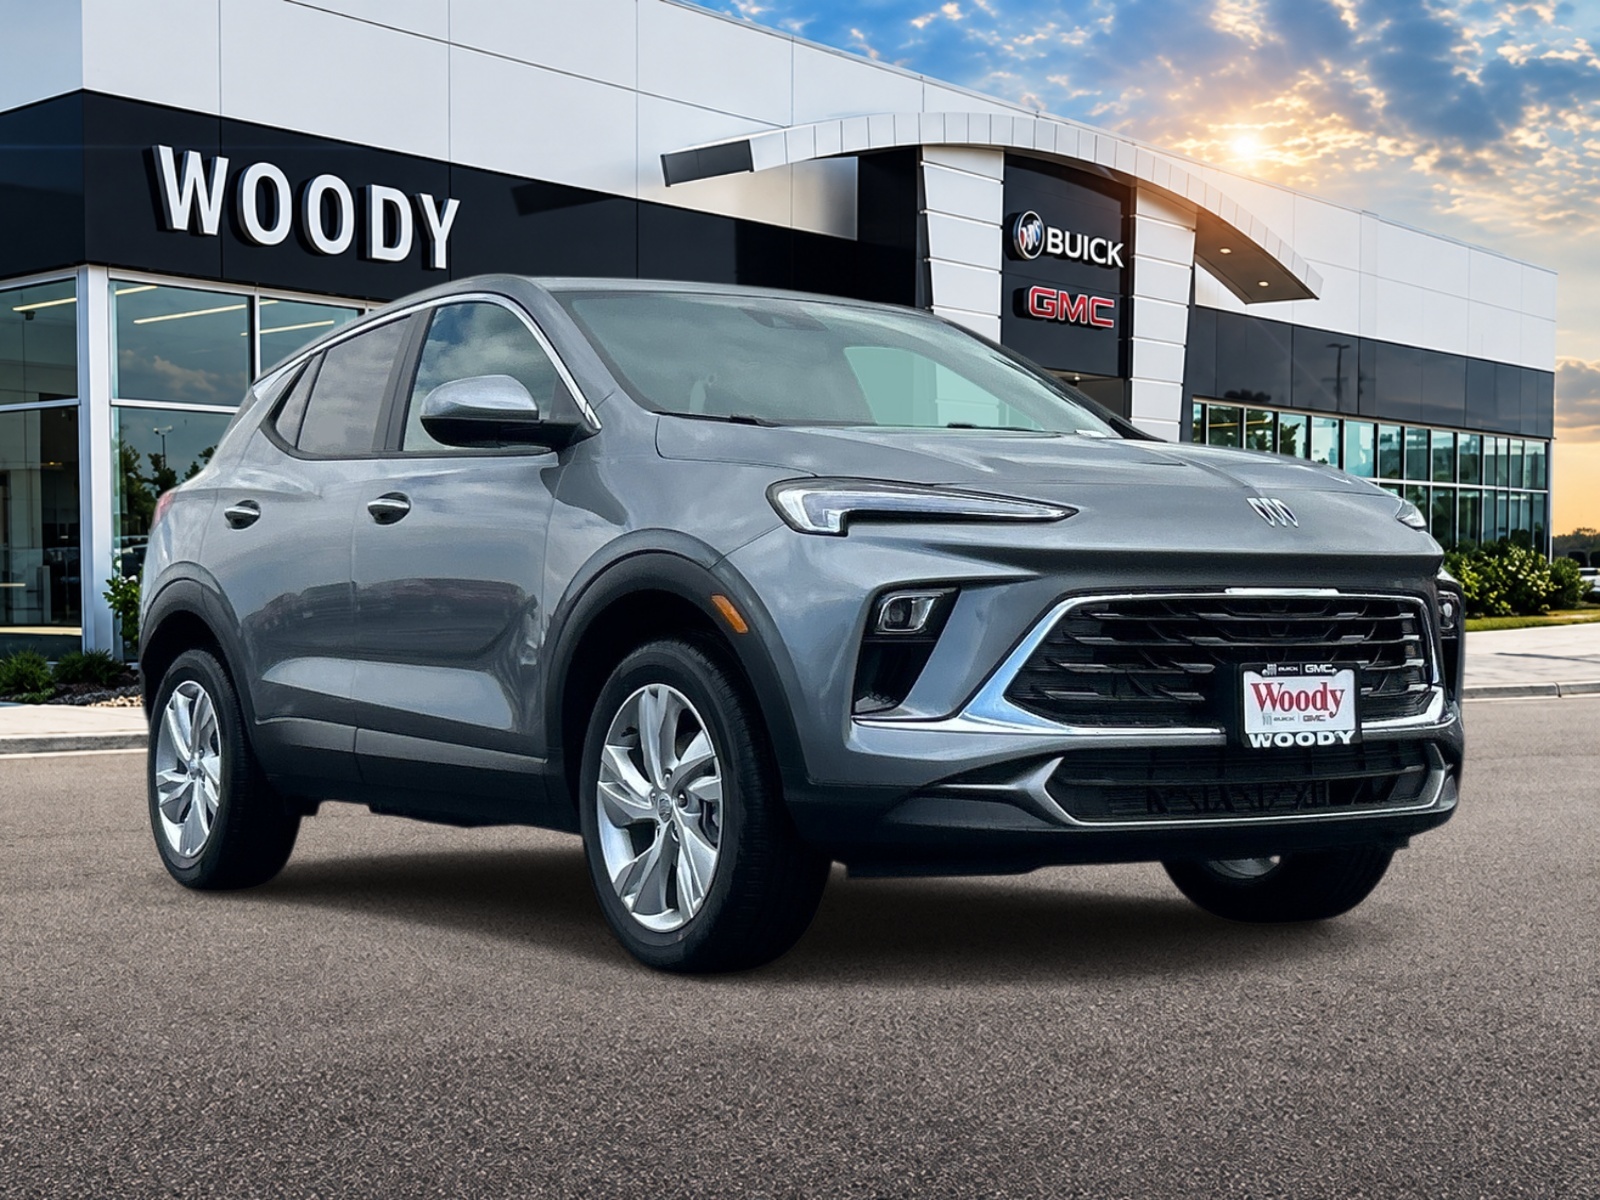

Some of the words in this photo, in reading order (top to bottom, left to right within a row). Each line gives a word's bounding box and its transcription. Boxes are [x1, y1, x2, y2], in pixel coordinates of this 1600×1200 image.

[152, 144, 460, 269] WOODY
[1046, 226, 1125, 268] BUICK
[1029, 285, 1114, 328] GMC
[1305, 664, 1332, 673] GMC
[1250, 682, 1345, 718] Woody
[1249, 730, 1355, 748] WOODY
